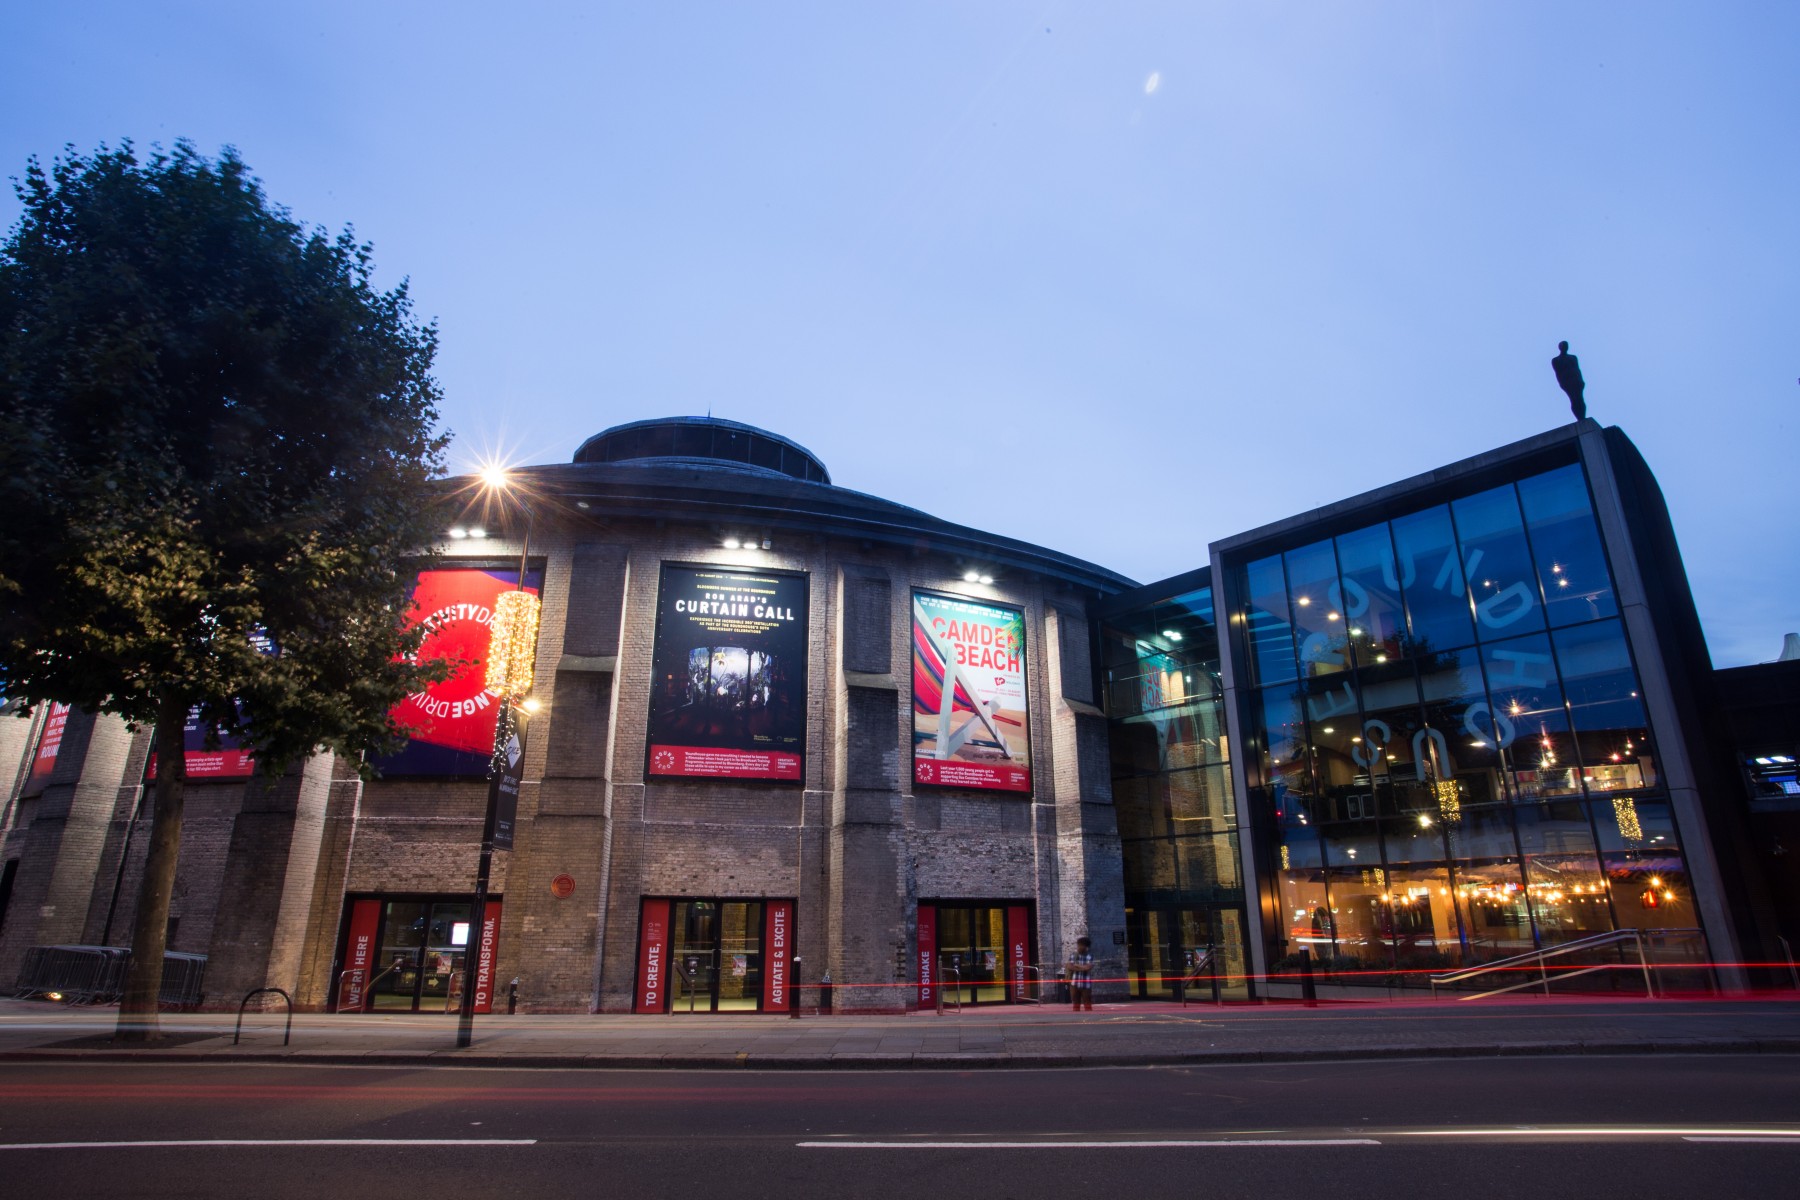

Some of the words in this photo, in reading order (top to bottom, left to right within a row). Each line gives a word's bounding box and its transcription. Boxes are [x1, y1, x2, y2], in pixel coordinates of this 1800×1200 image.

[676, 600, 748, 617] CURTAIN
[754, 606, 794, 621] CALL
[730, 594, 767, 604] ARAD'S
[933, 617, 1018, 651] CAMDEN
[954, 643, 1020, 673] BEACH
[1301, 544, 1552, 781] ROUNDHOUSE
[655, 750, 675, 770] ROUNDHOUSE
[917, 764, 933, 781] ROUNDHOUSE
[774, 908, 785, 947] EXCITE.
[355, 935, 368, 965] HERE
[478, 918, 495, 989] TRANSFORM.
[774, 950, 784, 958] &
[647, 943, 661, 988] CREATE,
[922, 951, 930, 985] SHAKE
[1016, 960, 1024, 995] THINGS
[772, 961, 783, 1004] AGITATE
[922, 988, 929, 1000] TO
[476, 992, 486, 1006] TO
[646, 992, 656, 1006] TO
